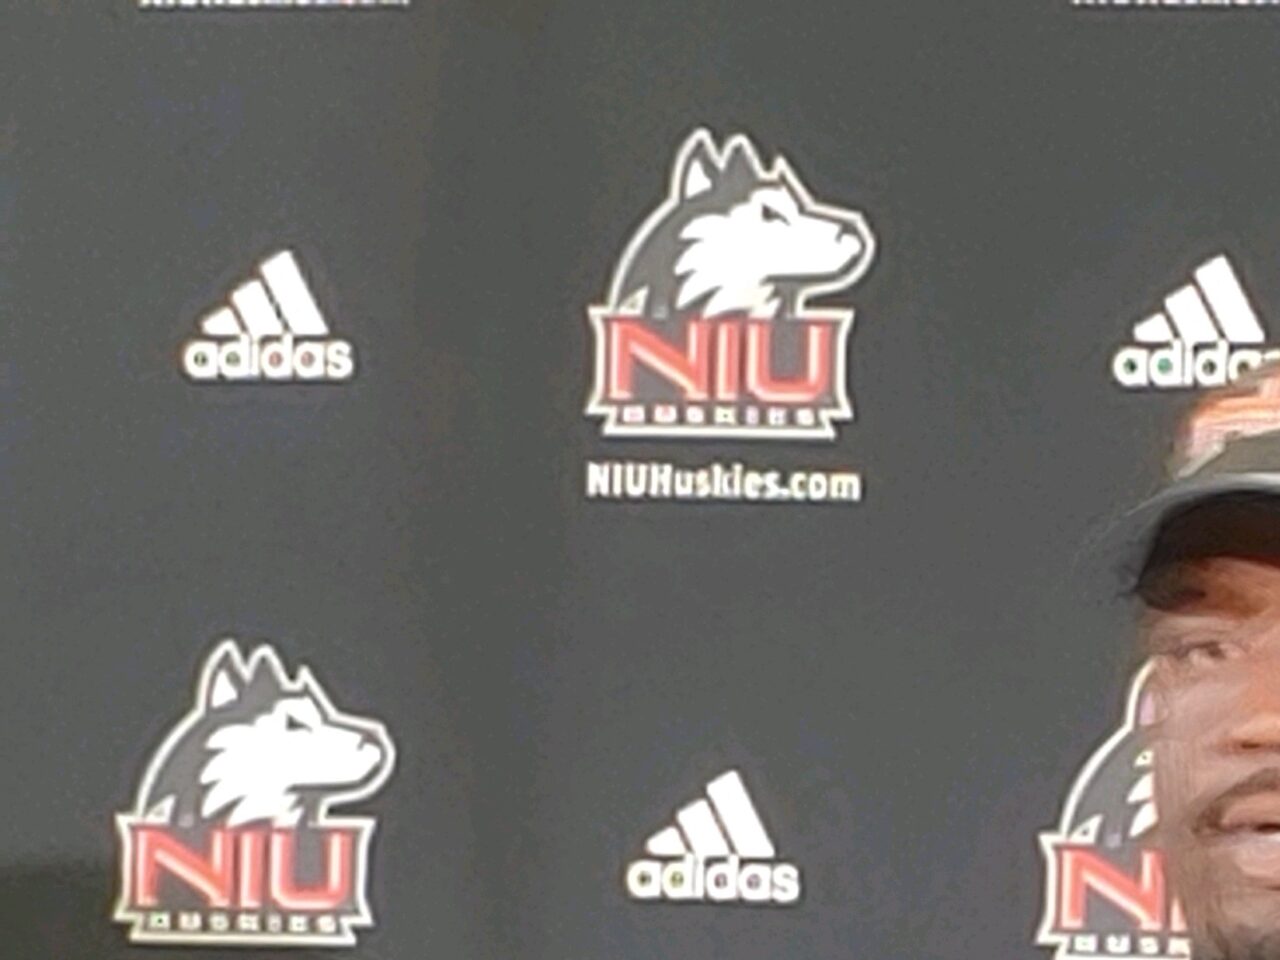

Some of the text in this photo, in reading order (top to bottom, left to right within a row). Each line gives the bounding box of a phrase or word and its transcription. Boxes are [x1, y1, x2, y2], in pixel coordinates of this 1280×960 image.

[184, 332, 354, 379] adidas
[609, 317, 833, 402] NIU
[586, 461, 862, 501] NIUHuskies.com
[136, 828, 352, 910] NIU
[627, 853, 801, 904] adidas
